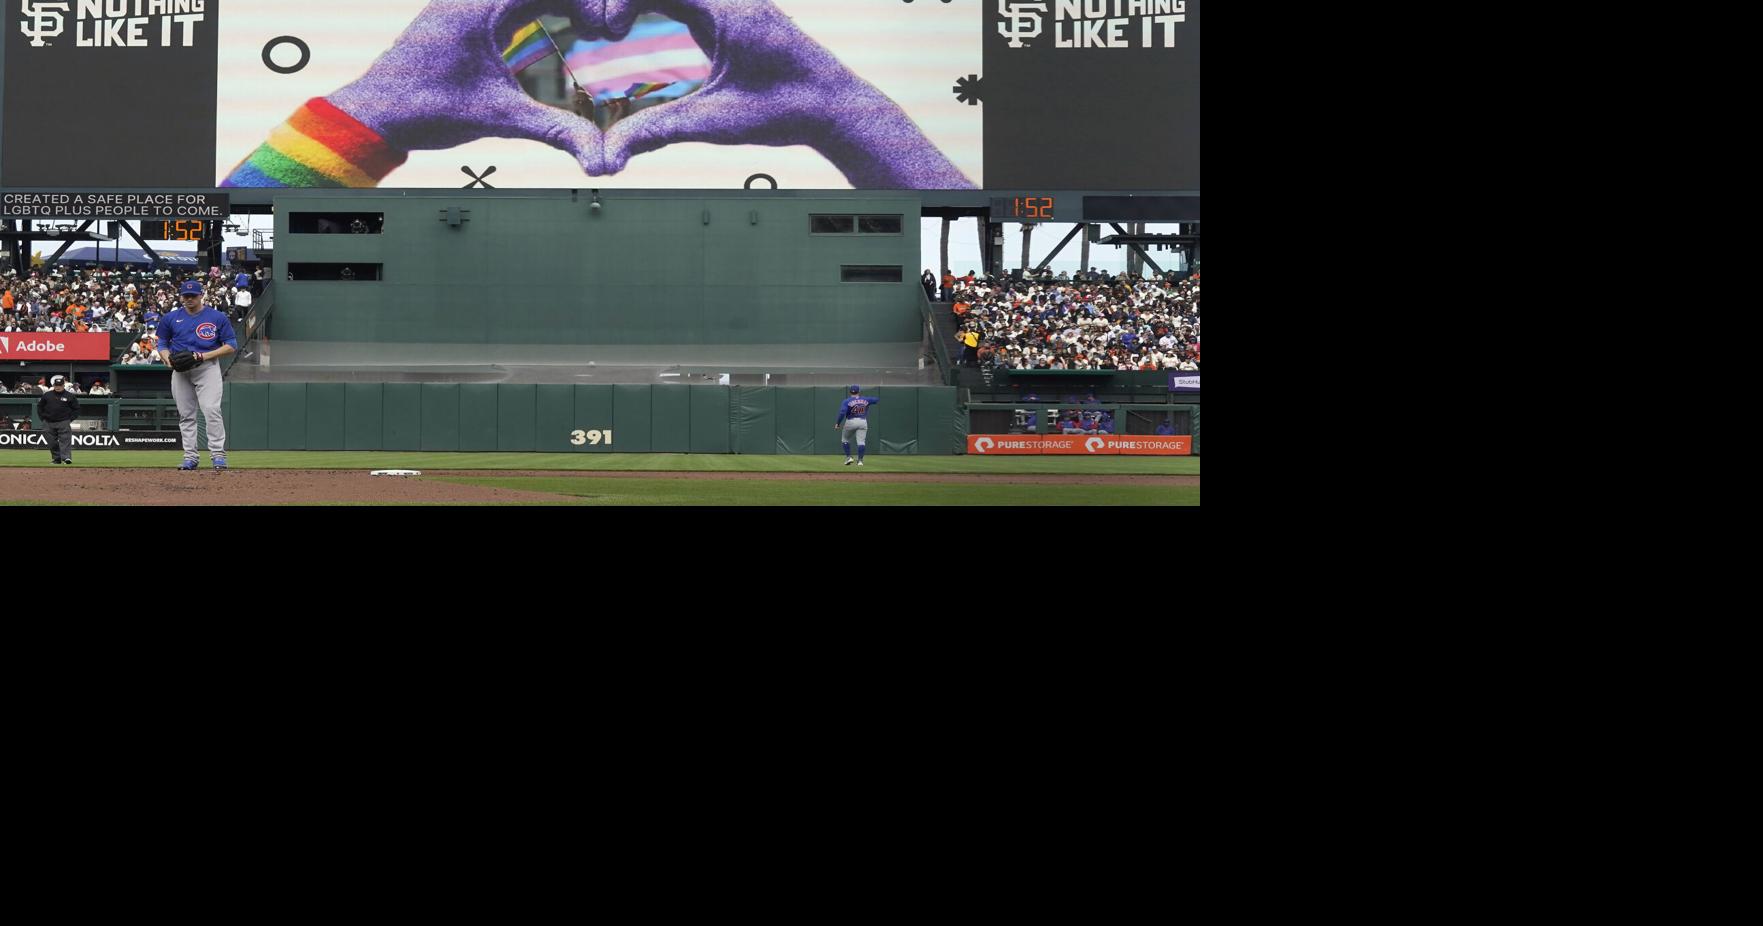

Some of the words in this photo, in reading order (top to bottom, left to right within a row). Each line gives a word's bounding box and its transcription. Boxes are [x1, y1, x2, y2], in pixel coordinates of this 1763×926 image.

[76, 17, 149, 47] LIKE
[161, 14, 204, 47] IT
[1055, 18, 1129, 48] LIKE
[1142, 14, 1185, 48] IT
[4, 194, 70, 204] CREATED
[74, 194, 84, 204] A
[87, 194, 123, 204] SAFE
[127, 194, 173, 204] PLACE
[177, 194, 206, 204] FOR
[3, 205, 51, 215] LGBTQ
[55, 205, 92, 215] PLUS
[95, 206, 149, 216] PEOPLE
[153, 206, 173, 216] TO
[177, 206, 222, 216] COME.
[1015, 197, 1053, 218] 1:52
[163, 219, 203, 240] 1:52
[16, 340, 65, 352] Adobe
[71, 434, 120, 446] NOLTA
[570, 429, 612, 445] 391
